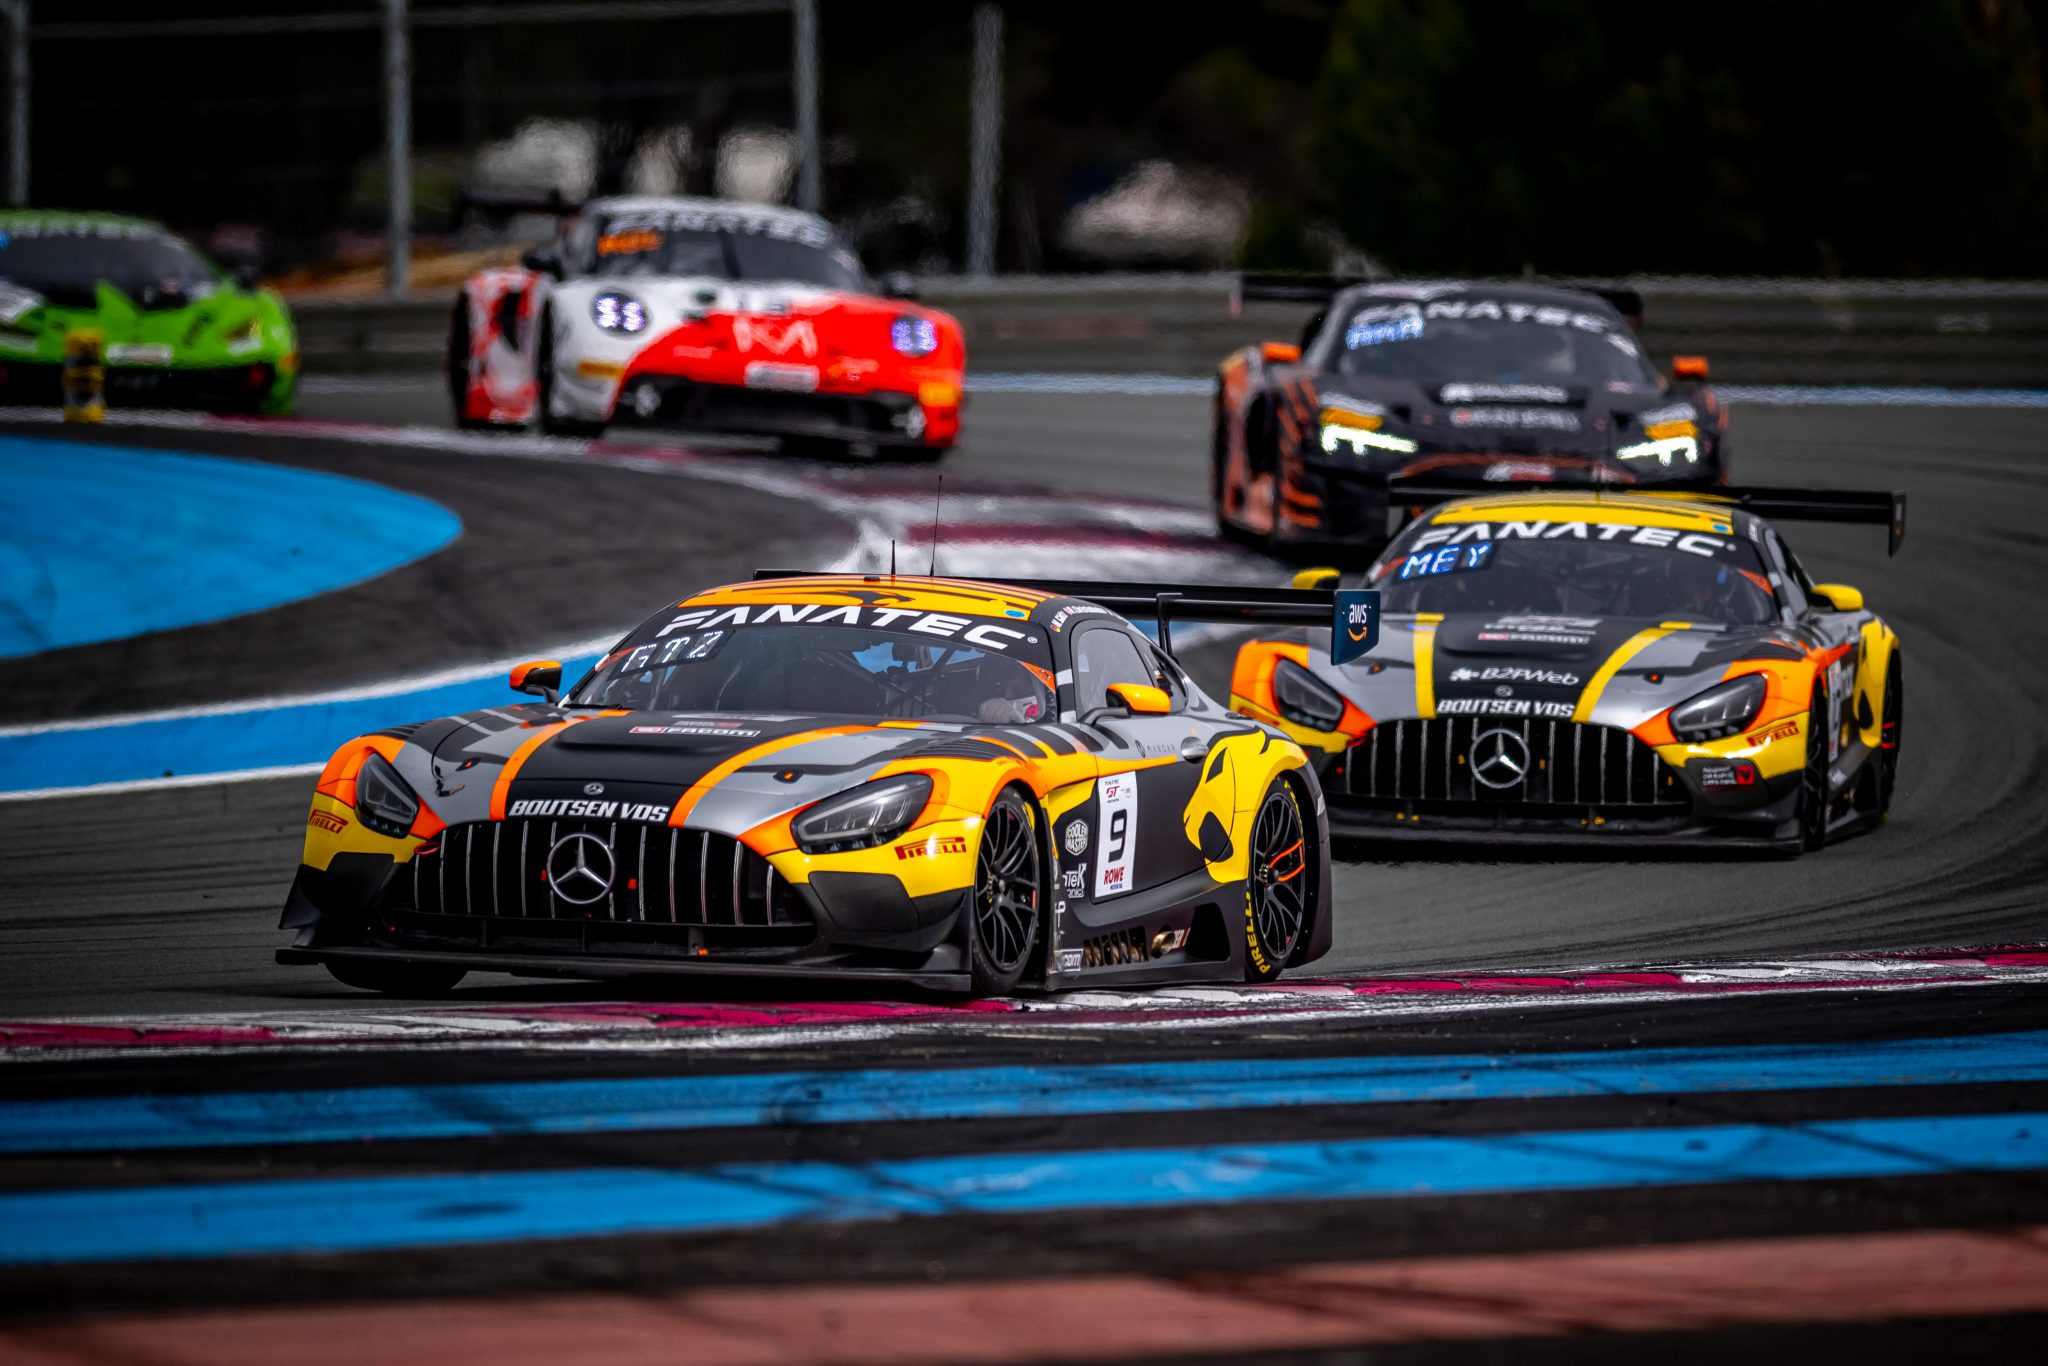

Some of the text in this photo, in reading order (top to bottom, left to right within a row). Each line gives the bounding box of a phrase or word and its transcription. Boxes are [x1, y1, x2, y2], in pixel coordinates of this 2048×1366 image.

[1410, 520, 1726, 557] FANATEC
[1349, 603, 1367, 624] aws
[655, 603, 1026, 650] FANATEC
[1437, 699, 1576, 718] BOUTSEN VDS
[309, 809, 349, 834] PIRELLI
[508, 799, 671, 822] BOUTSEN VDS
[1067, 823, 1087, 839] COOLER
[1108, 808, 1128, 863] 9
[894, 836, 967, 860] PIRELLI
[1066, 837, 1086, 853] MASTER
[1103, 866, 1125, 886] ROWE
